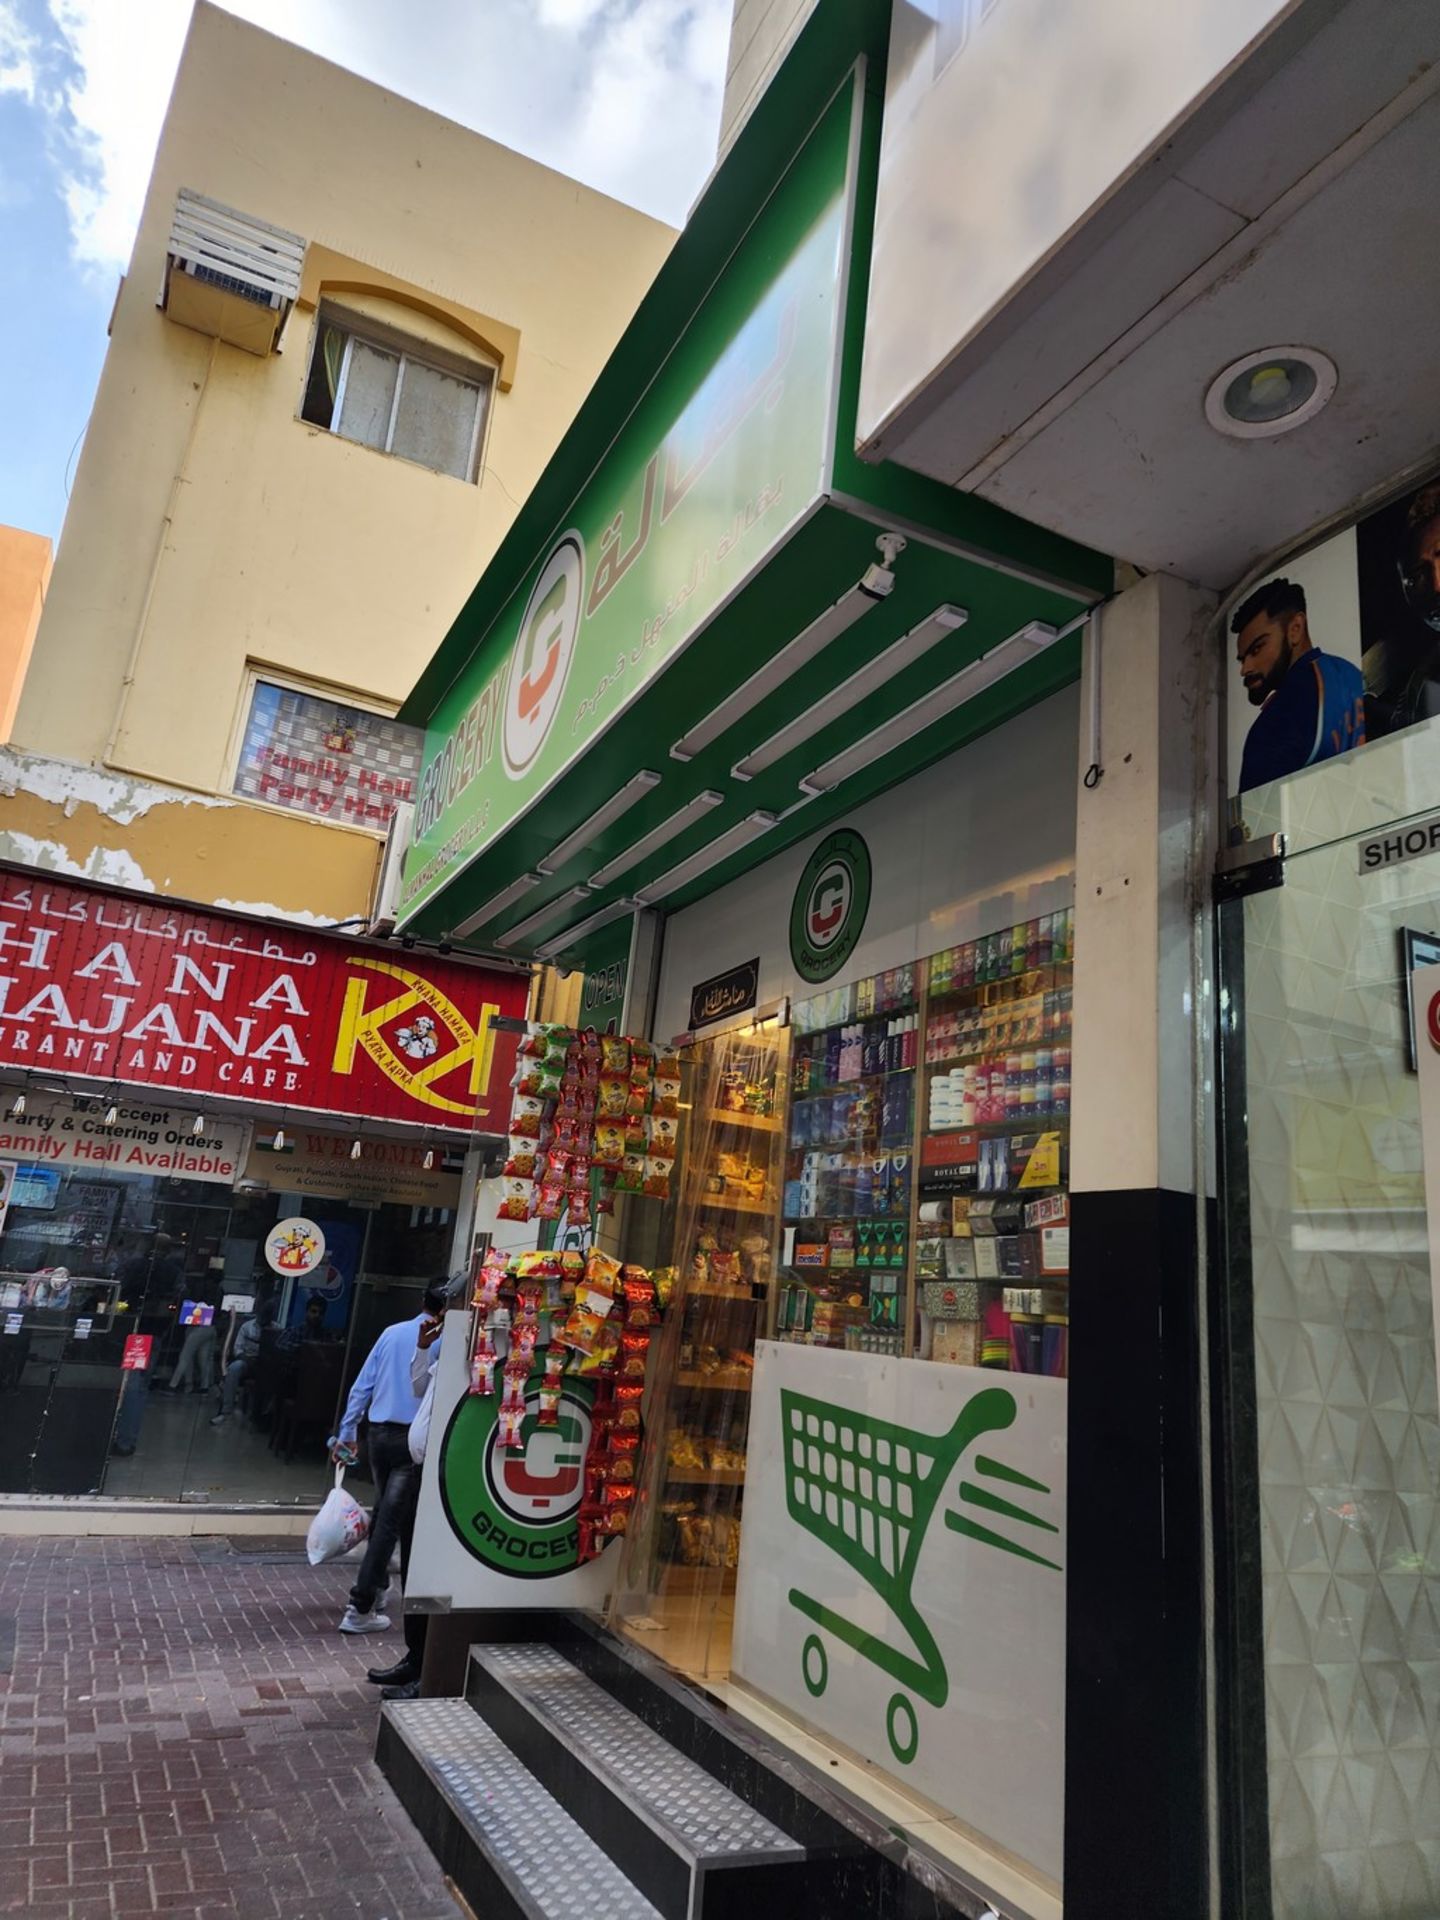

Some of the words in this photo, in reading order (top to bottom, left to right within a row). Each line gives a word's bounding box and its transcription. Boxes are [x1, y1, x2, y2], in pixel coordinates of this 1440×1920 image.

[255, 744, 350, 787] Family
[358, 768, 412, 800] Hall
[412, 659, 510, 848] GROCERY
[259, 773, 338, 812] Party
[799, 932, 852, 971] GROCERY
[411, 978, 441, 1010] KHANA
[440, 1007, 472, 1046] HAMARA
[585, 958, 627, 1012] OPEN
[0, 1027, 109, 1062] RANT
[128, 1049, 197, 1075] AND
[218, 1062, 298, 1091] CAFE
[362, 1029, 388, 1060] PYARA
[384, 1056, 414, 1086] AAPKA
[61, 1116, 74, 1131] &
[82, 1119, 159, 1145] Catering
[164, 1130, 223, 1150] Orders
[73, 1139, 122, 1162] Hall
[126, 1146, 232, 1176] Available
